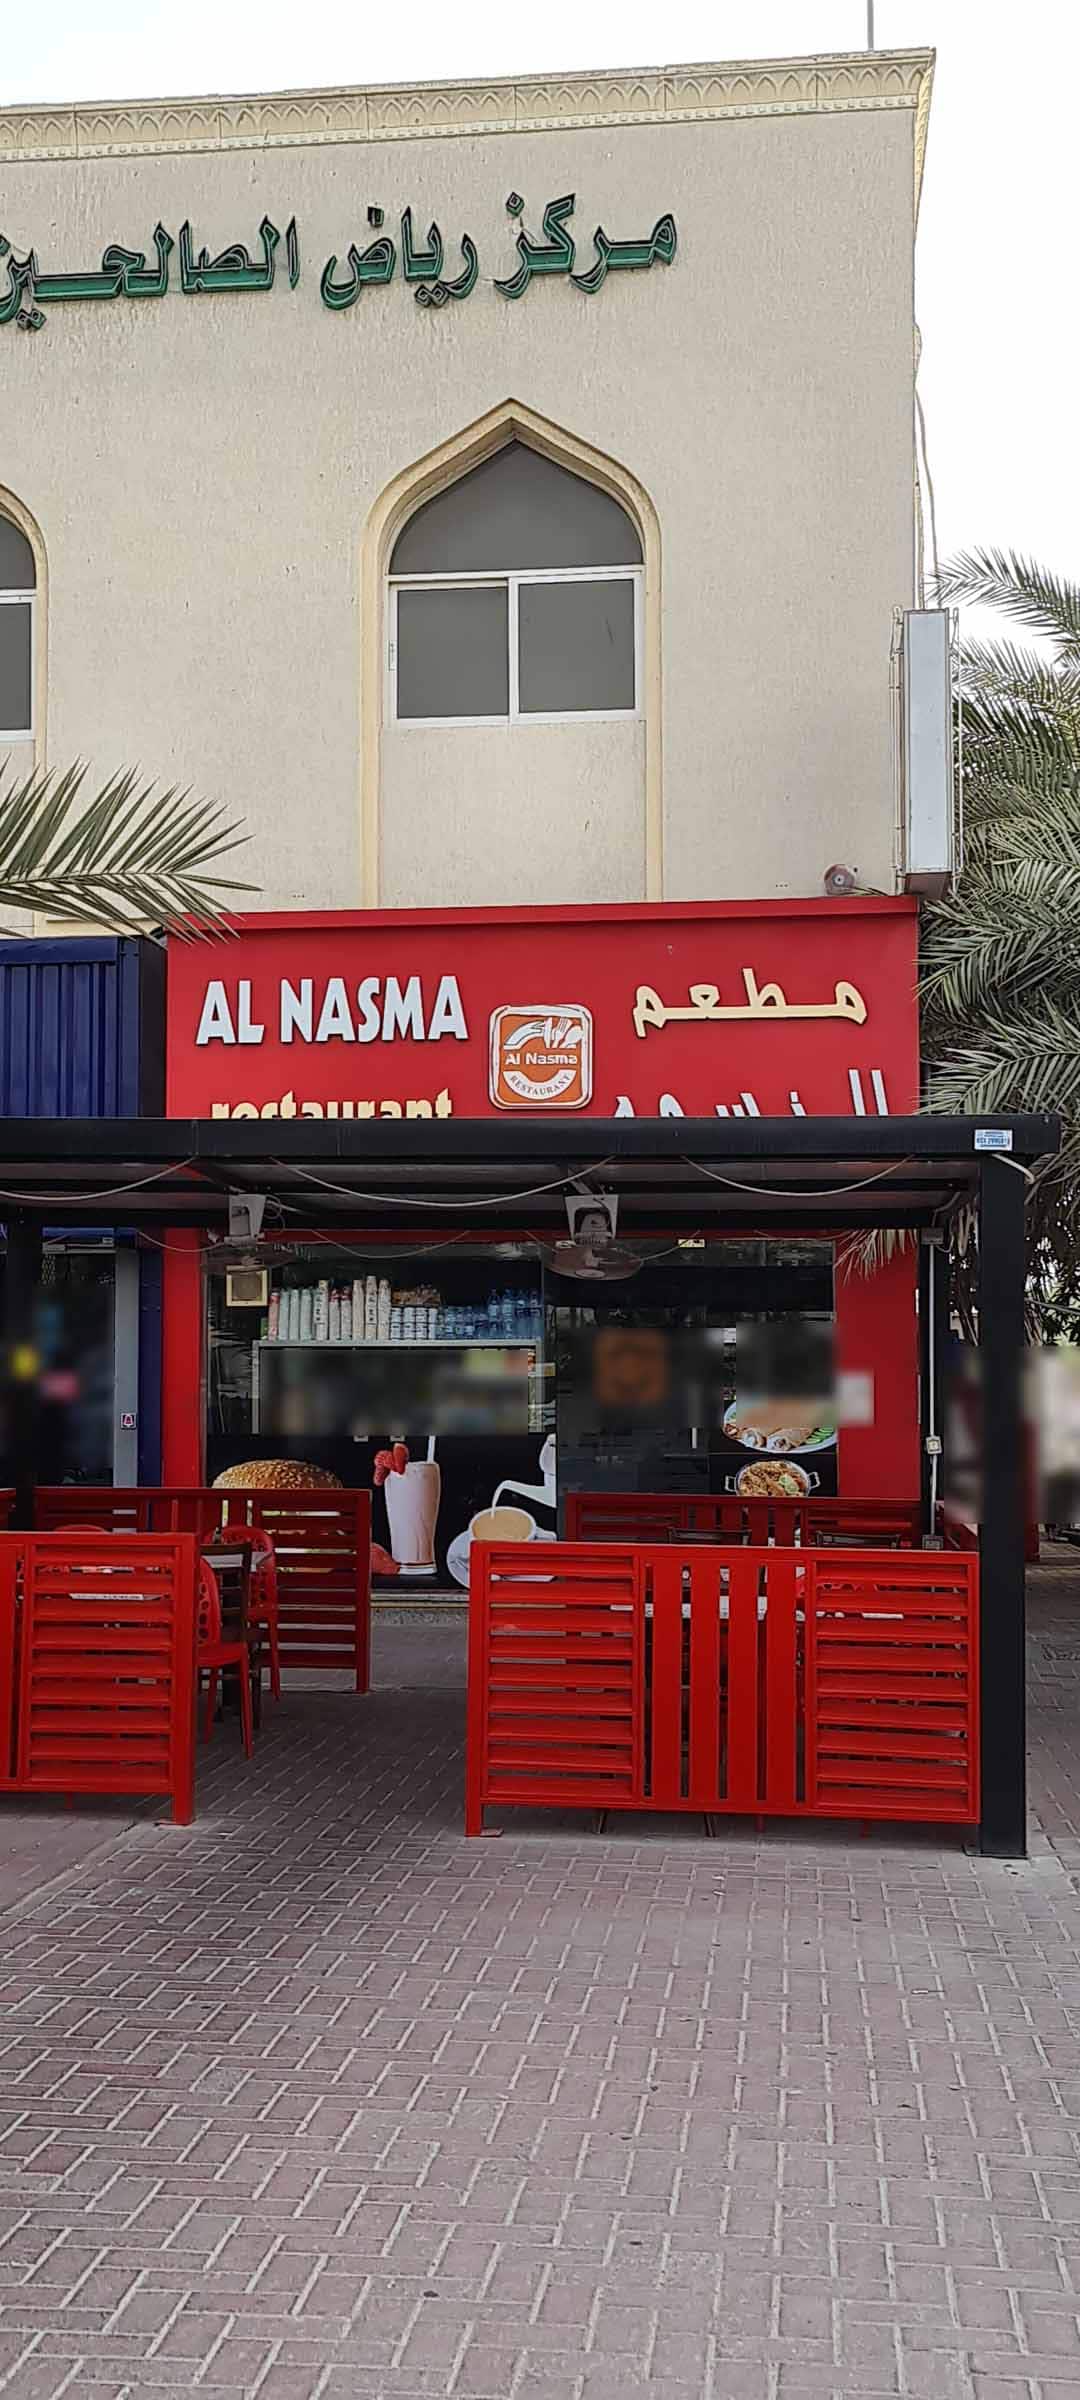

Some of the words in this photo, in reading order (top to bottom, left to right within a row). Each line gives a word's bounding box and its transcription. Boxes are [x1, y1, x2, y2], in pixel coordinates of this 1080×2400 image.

[320, 205, 479, 310] رياض
[493, 191, 677, 299] مركز
[196, 979, 265, 1045] AL
[281, 975, 469, 1043] NASMA
[632, 967, 868, 1038] مطعم
[510, 1074, 571, 1096] RESTAURANT
[525, 1052, 578, 1065] Nasma
